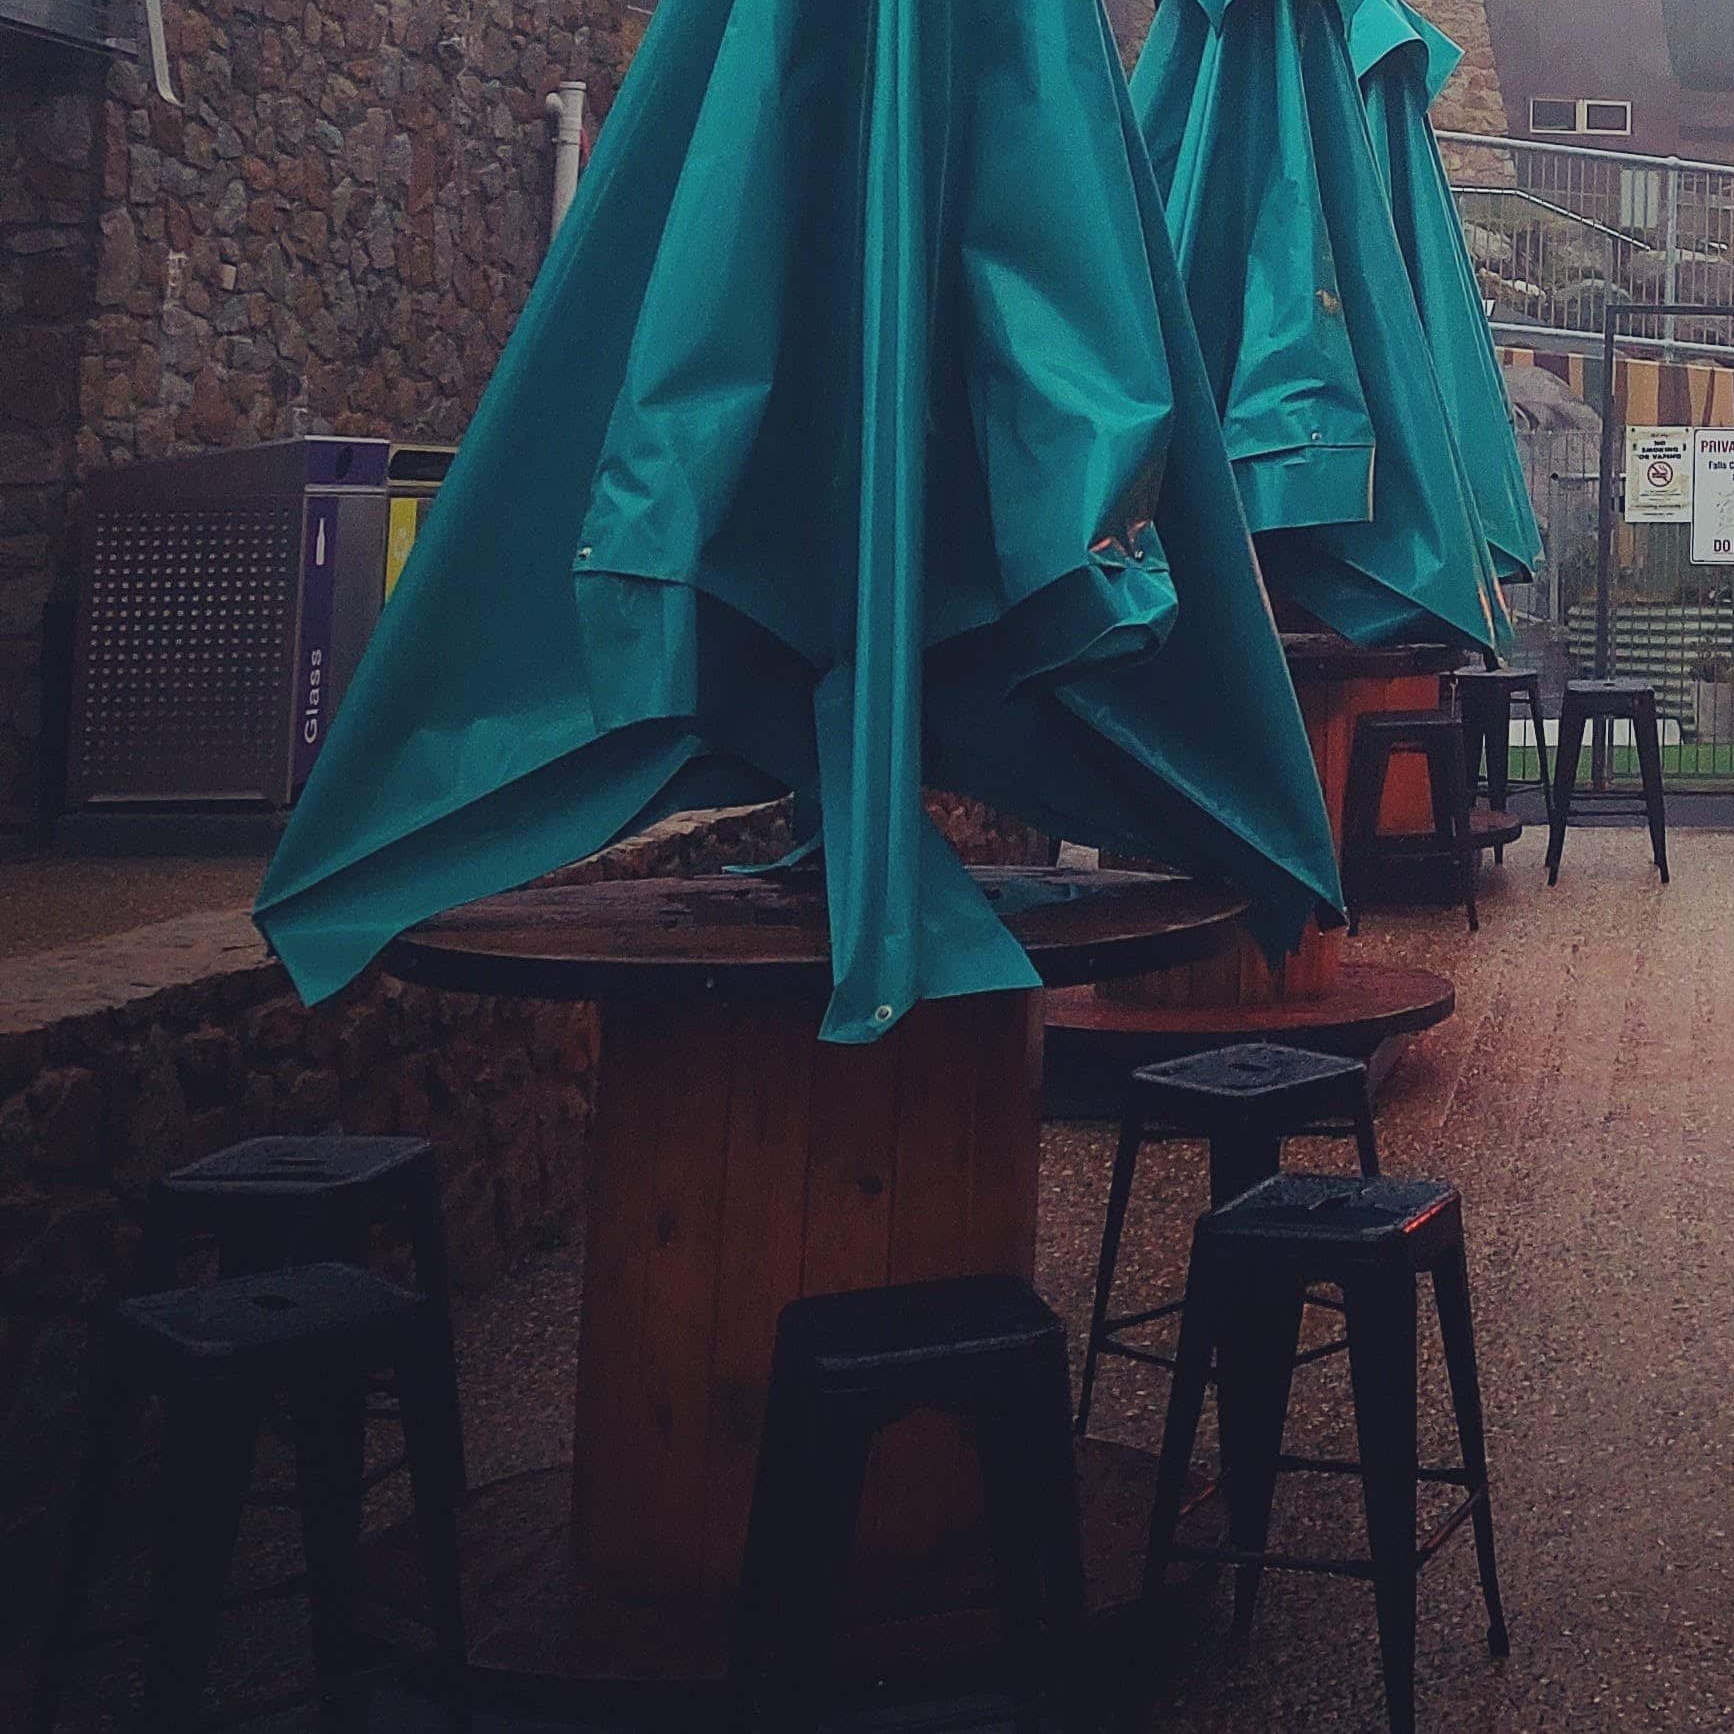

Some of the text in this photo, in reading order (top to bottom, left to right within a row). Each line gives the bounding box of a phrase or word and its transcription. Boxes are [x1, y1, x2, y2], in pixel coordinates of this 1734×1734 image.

[1708, 461, 1727, 470] Falls
[1713, 539, 1731, 552] DO
[304, 648, 322, 744] Glass
